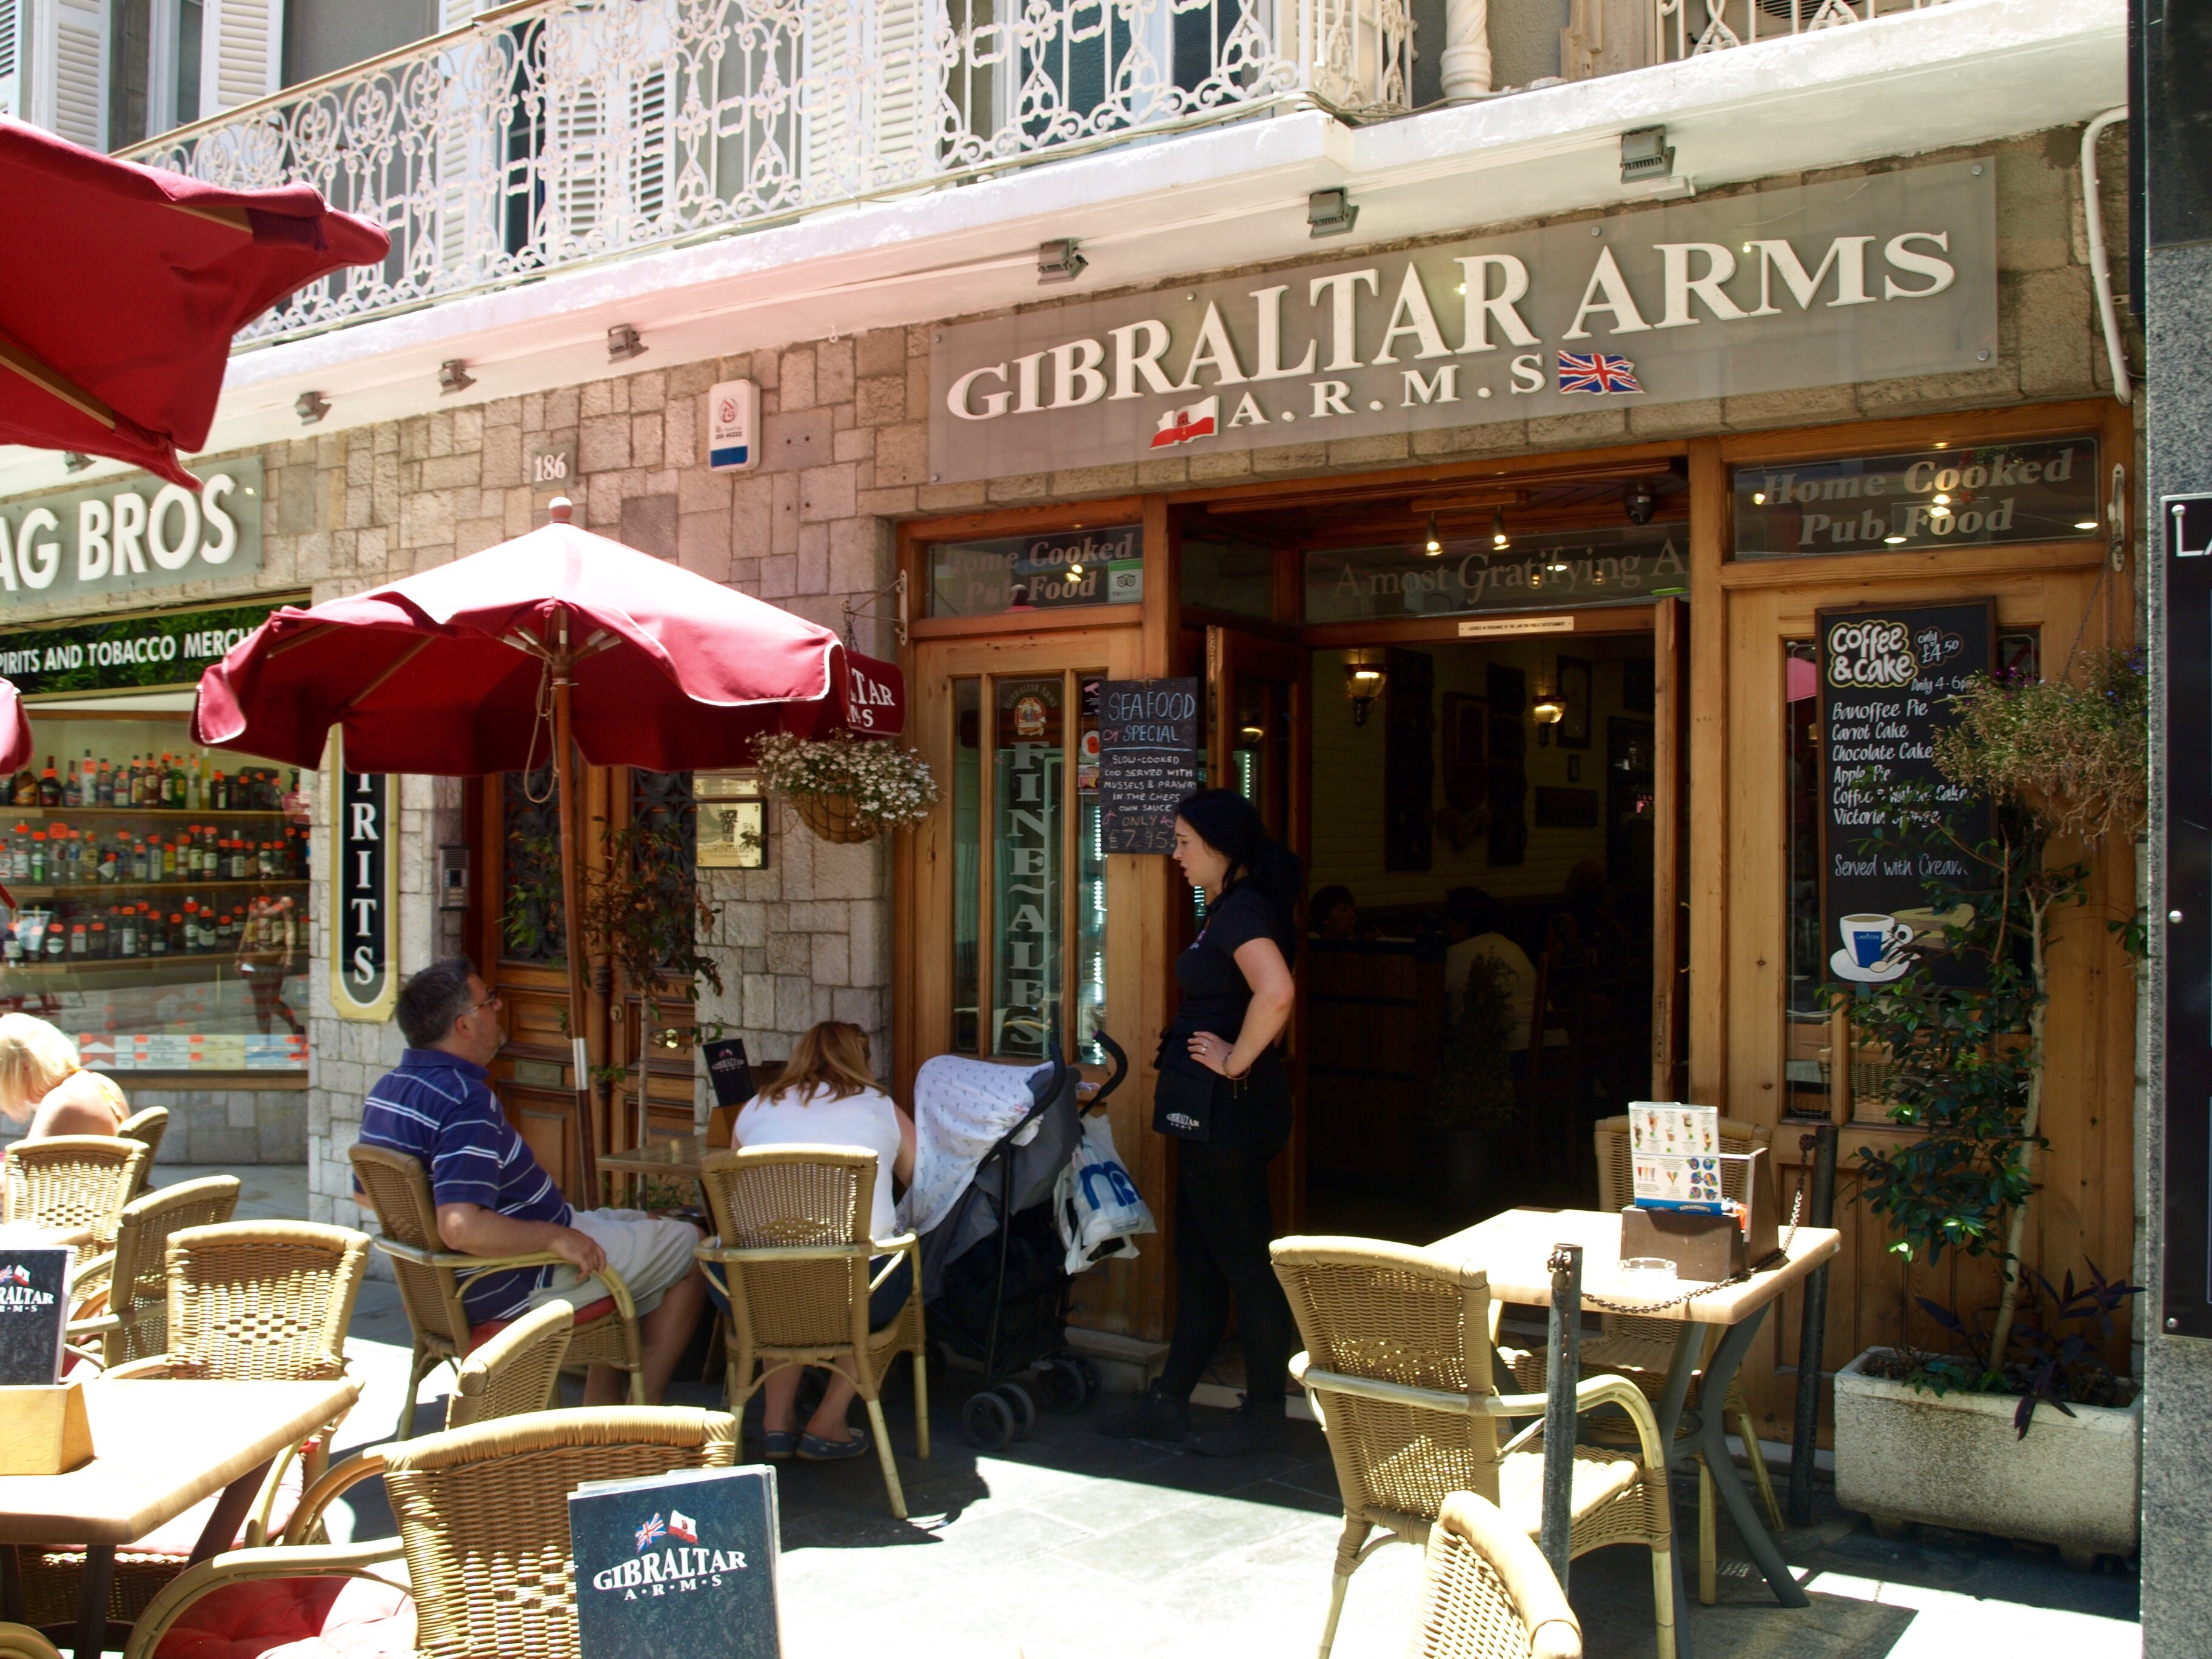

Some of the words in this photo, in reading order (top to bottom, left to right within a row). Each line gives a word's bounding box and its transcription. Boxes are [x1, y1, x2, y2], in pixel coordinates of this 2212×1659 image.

[947, 253, 1541, 421] GIBRALTAR
[1562, 231, 1956, 340] ARMS
[535, 452, 567, 481] 186
[1762, 473, 1885, 505] Home
[1903, 447, 2074, 493] Cooked
[79, 474, 238, 581] BROS
[1798, 512, 1885, 545] Pub
[1904, 498, 2016, 537] Food
[2176, 513, 2212, 557] L
[945, 551, 1020, 573] Home
[1030, 533, 1133, 566] Cooked
[967, 578, 1017, 606] Pub
[1028, 571, 1097, 601] Food
[1368, 564, 1449, 595] most
[1458, 546, 1641, 603] Gratifying
[44, 645, 83, 671] AND
[87, 635, 176, 667] TOBACCO
[1832, 624, 1903, 661] Coffee
[1108, 691, 1195, 721] SEAFOOD
[1832, 702, 1900, 722] Banoffee
[1906, 699, 1928, 717] Pie
[1123, 725, 1179, 743] SPECIAL
[1832, 724, 1871, 741] Carrot
[1875, 722, 1909, 739] Cake
[1112, 755, 1179, 765] SLOW-COOKED
[1832, 745, 1895, 762] Chocolate
[1899, 742, 1932, 759] Cake
[1167, 768, 1193, 777] WITH
[1149, 793, 1180, 802] CHEFS
[1122, 816, 1158, 826] ONLY
[1835, 854, 1877, 876] Served
[1884, 855, 1912, 876] with
[593, 1547, 748, 1590] GIBRALTAR
